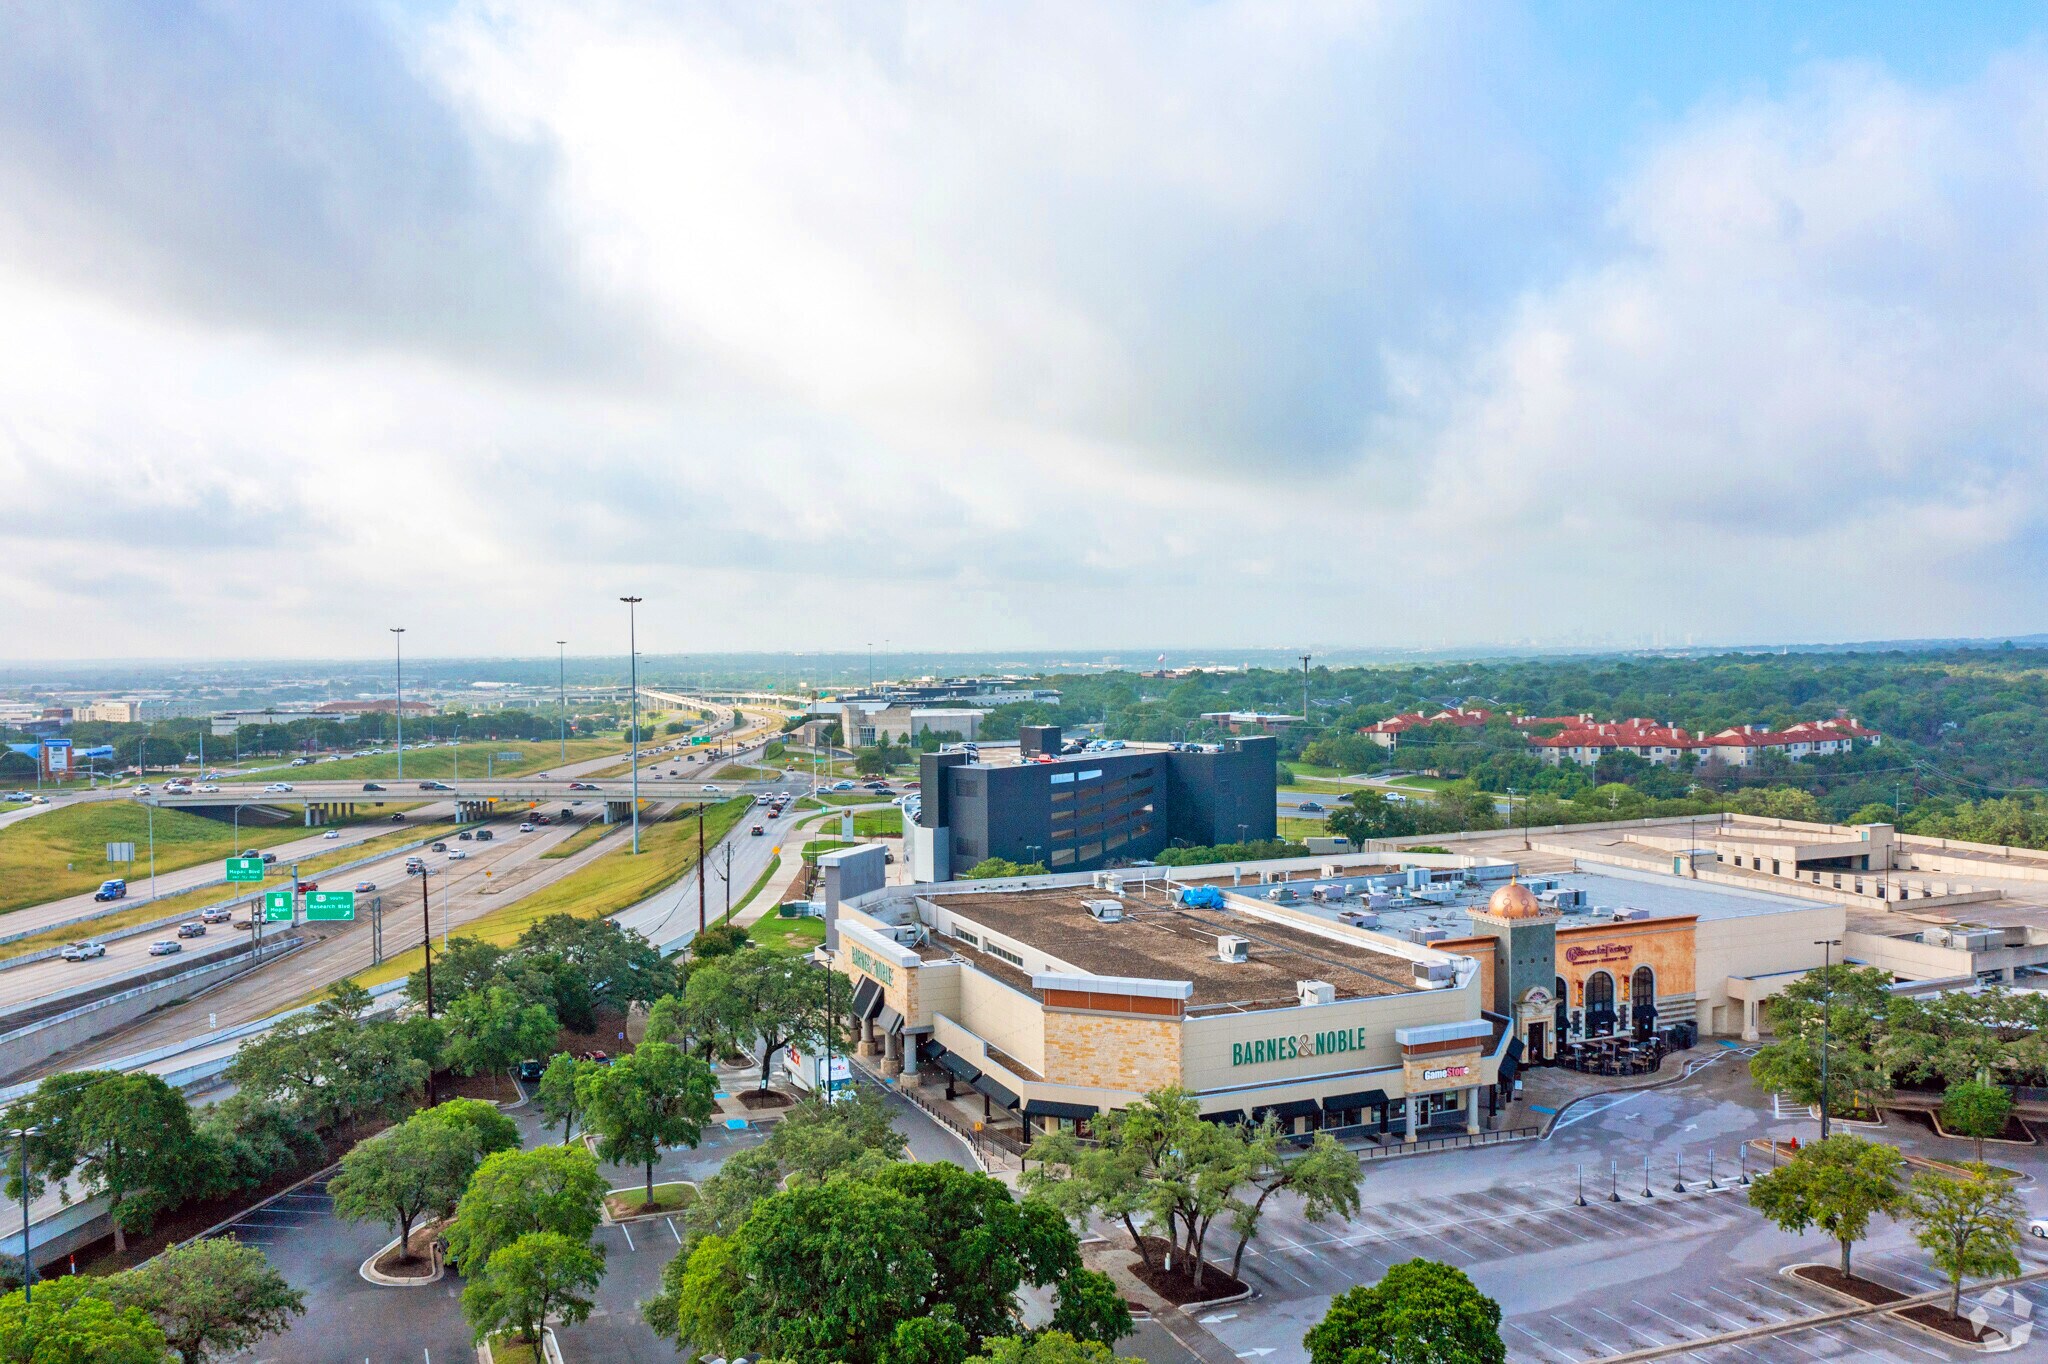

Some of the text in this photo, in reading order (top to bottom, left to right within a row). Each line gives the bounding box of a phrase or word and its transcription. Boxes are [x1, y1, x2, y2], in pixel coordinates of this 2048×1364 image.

[1232, 1027, 1366, 1066] BARNES & NOBLE
